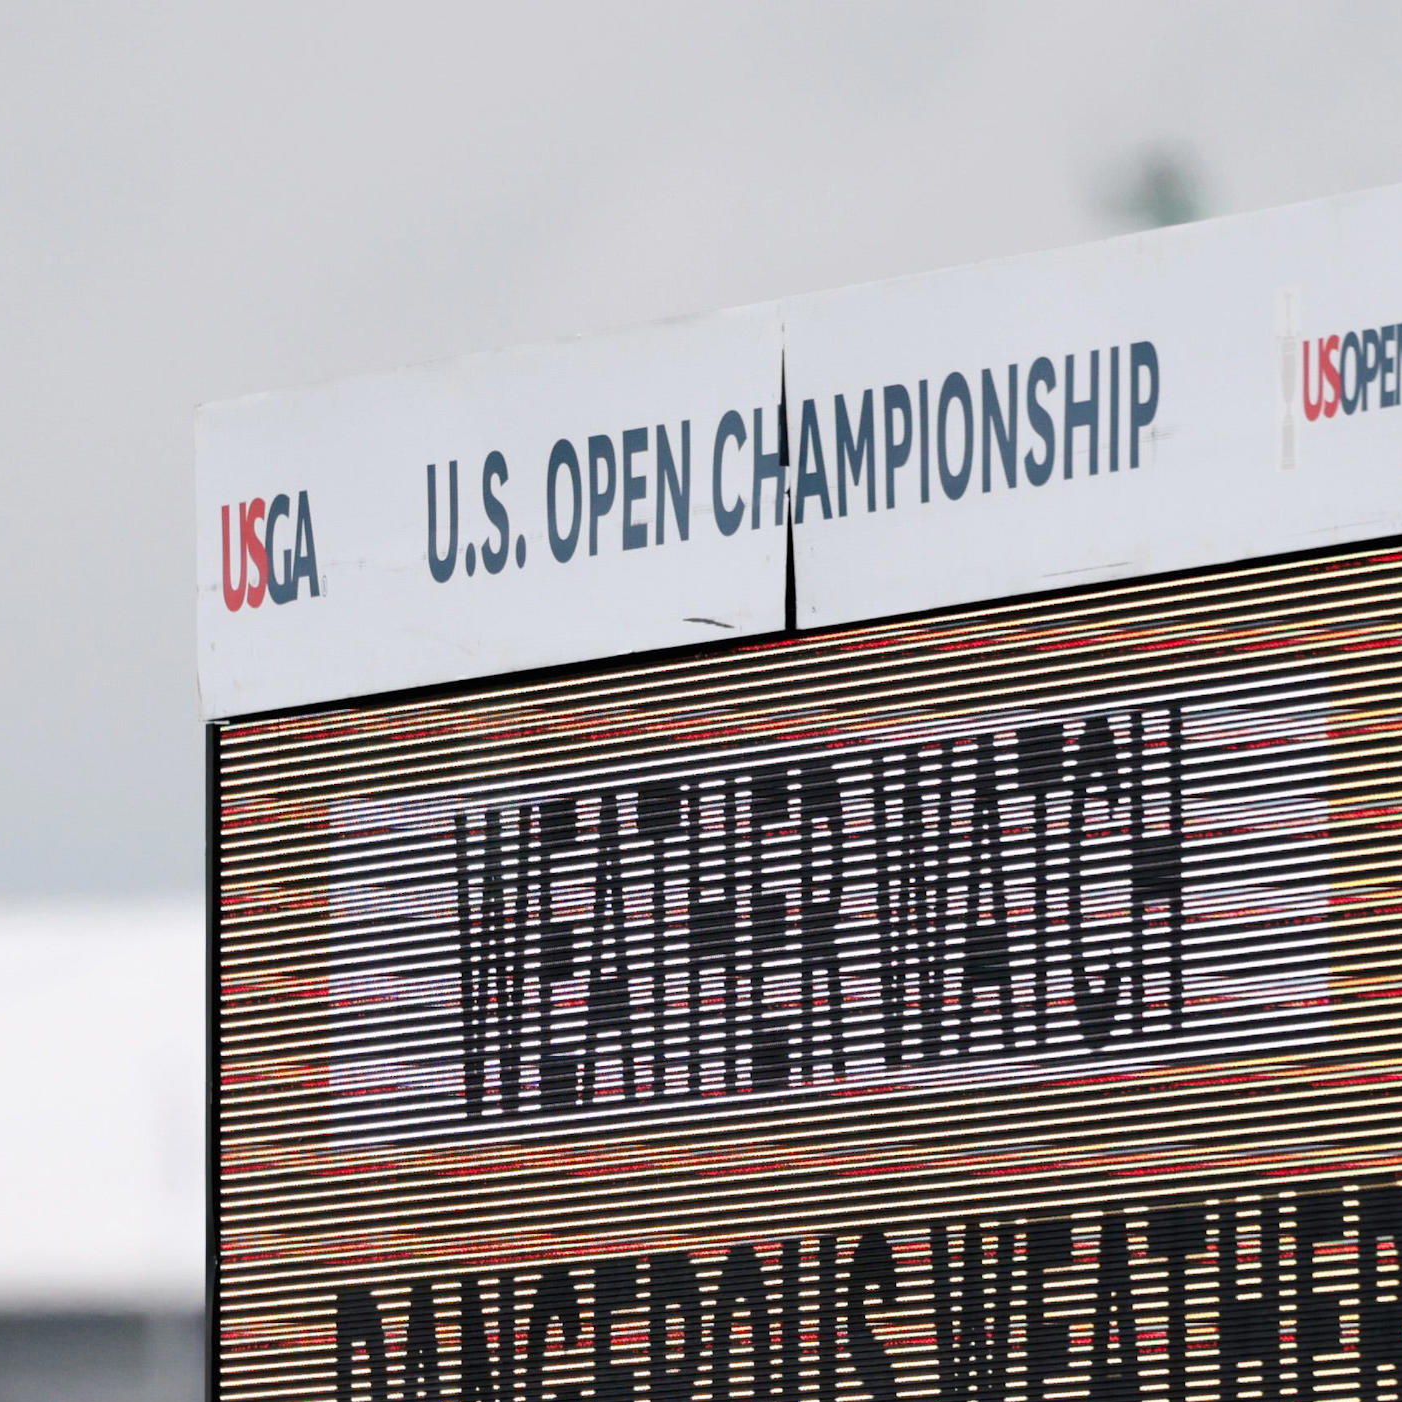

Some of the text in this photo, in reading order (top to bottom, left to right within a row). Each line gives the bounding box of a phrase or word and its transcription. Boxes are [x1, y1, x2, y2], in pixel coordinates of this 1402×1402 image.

[221, 490, 320, 612] USGA
[426, 340, 1160, 583] U.S. OPEN CHAMPIONSHIP
[456, 705, 1184, 1120] WEATHER WATCH
